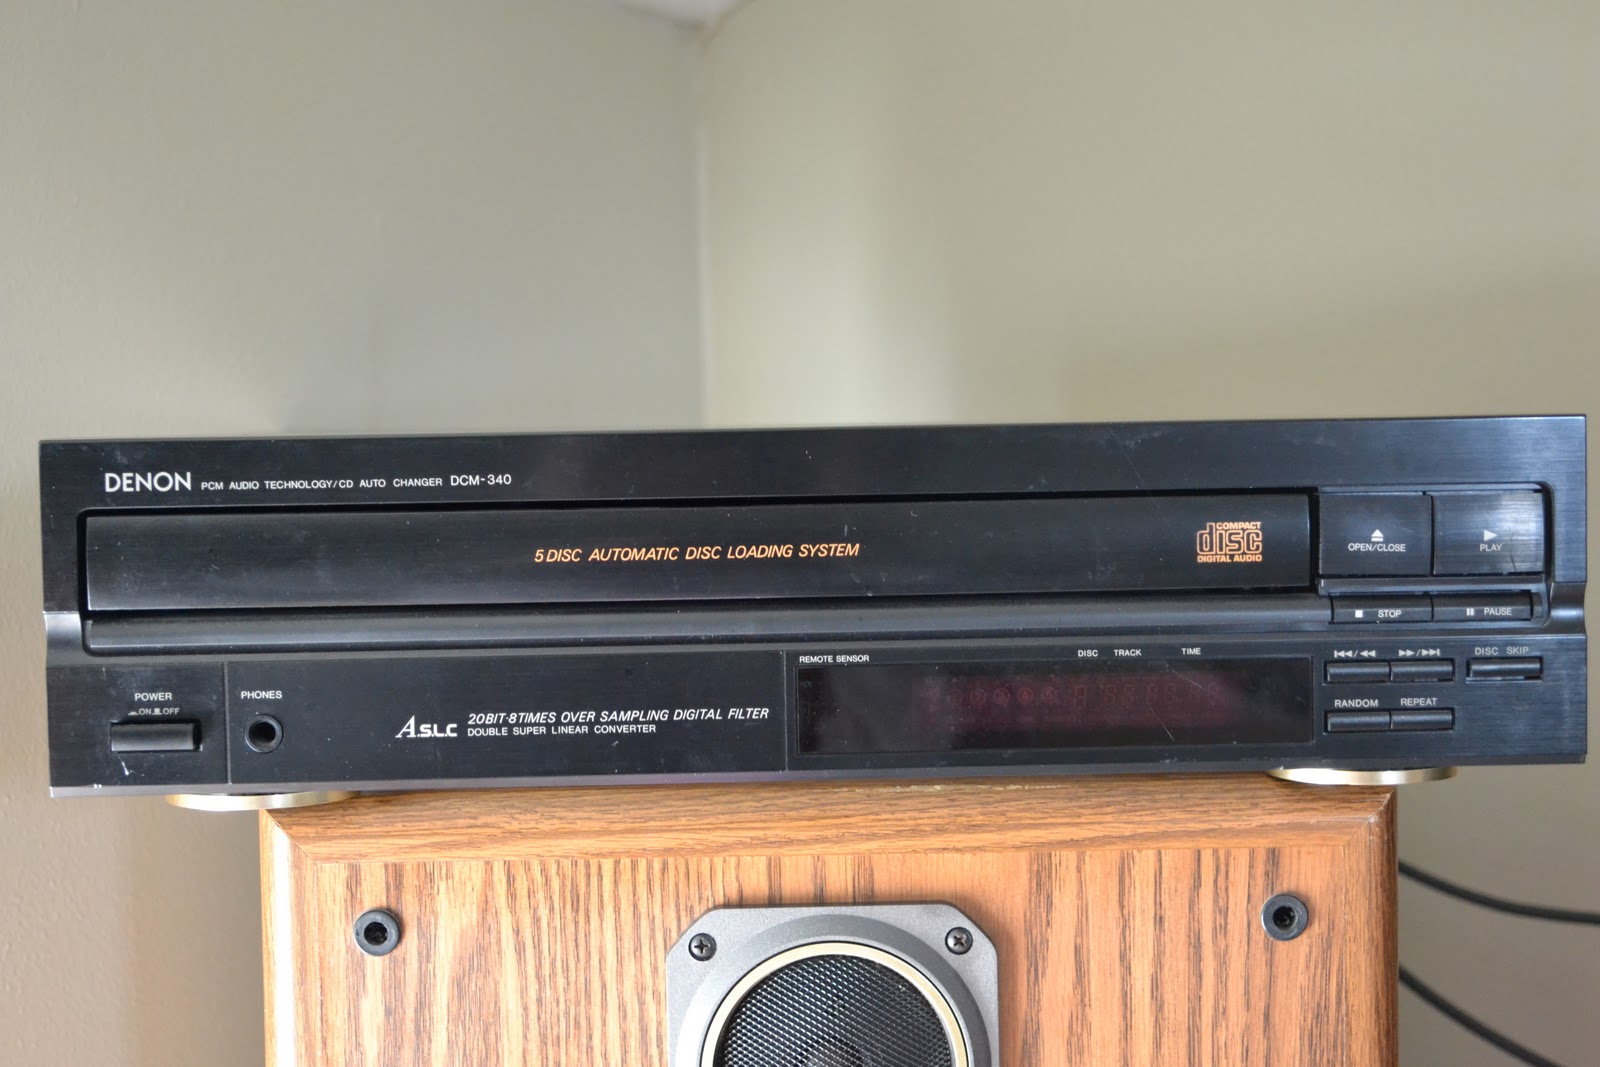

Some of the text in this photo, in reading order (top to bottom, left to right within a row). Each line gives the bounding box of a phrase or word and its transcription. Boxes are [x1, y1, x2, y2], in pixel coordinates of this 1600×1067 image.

[105, 471, 192, 493] DENON
[201, 474, 512, 491] PCM AUDIO TECHNOLOGY/CD AUTO CHANGER DCM-340
[1216, 521, 1262, 530] COMPACT
[588, 547, 680, 561] AUTOMATIC
[685, 546, 722, 560] DISC
[727, 545, 794, 559] LOADING
[798, 543, 860, 557] SYSTEM
[1347, 543, 1406, 553] OPEN/CLOSE
[1479, 544, 1503, 552] PLAY
[1197, 554, 1263, 563] DIGITAL AUDIO
[1377, 609, 1402, 618] STOP
[1483, 606, 1513, 616] PAUSE
[1077, 649, 1099, 658] DISC
[1113, 648, 1142, 657] TRACK
[1181, 647, 1201, 656] TIME
[1474, 645, 1529, 656] DISC SKIP
[799, 654, 870, 664] REMOTE SENSOR
[134, 692, 172, 702] POWER
[240, 690, 283, 700] PHONES
[1334, 698, 1379, 708] RANDOM
[1400, 697, 1438, 707] REPEAT
[138, 707, 151, 716] ON
[162, 707, 180, 716] OFF
[560, 710, 596, 723] OVER
[599, 709, 670, 723] SAMPLING
[673, 708, 723, 721] DIGITAL
[727, 707, 770, 720] FILTER
[467, 724, 657, 737] DOUBLE SUPER LINEAR CONVERTER
